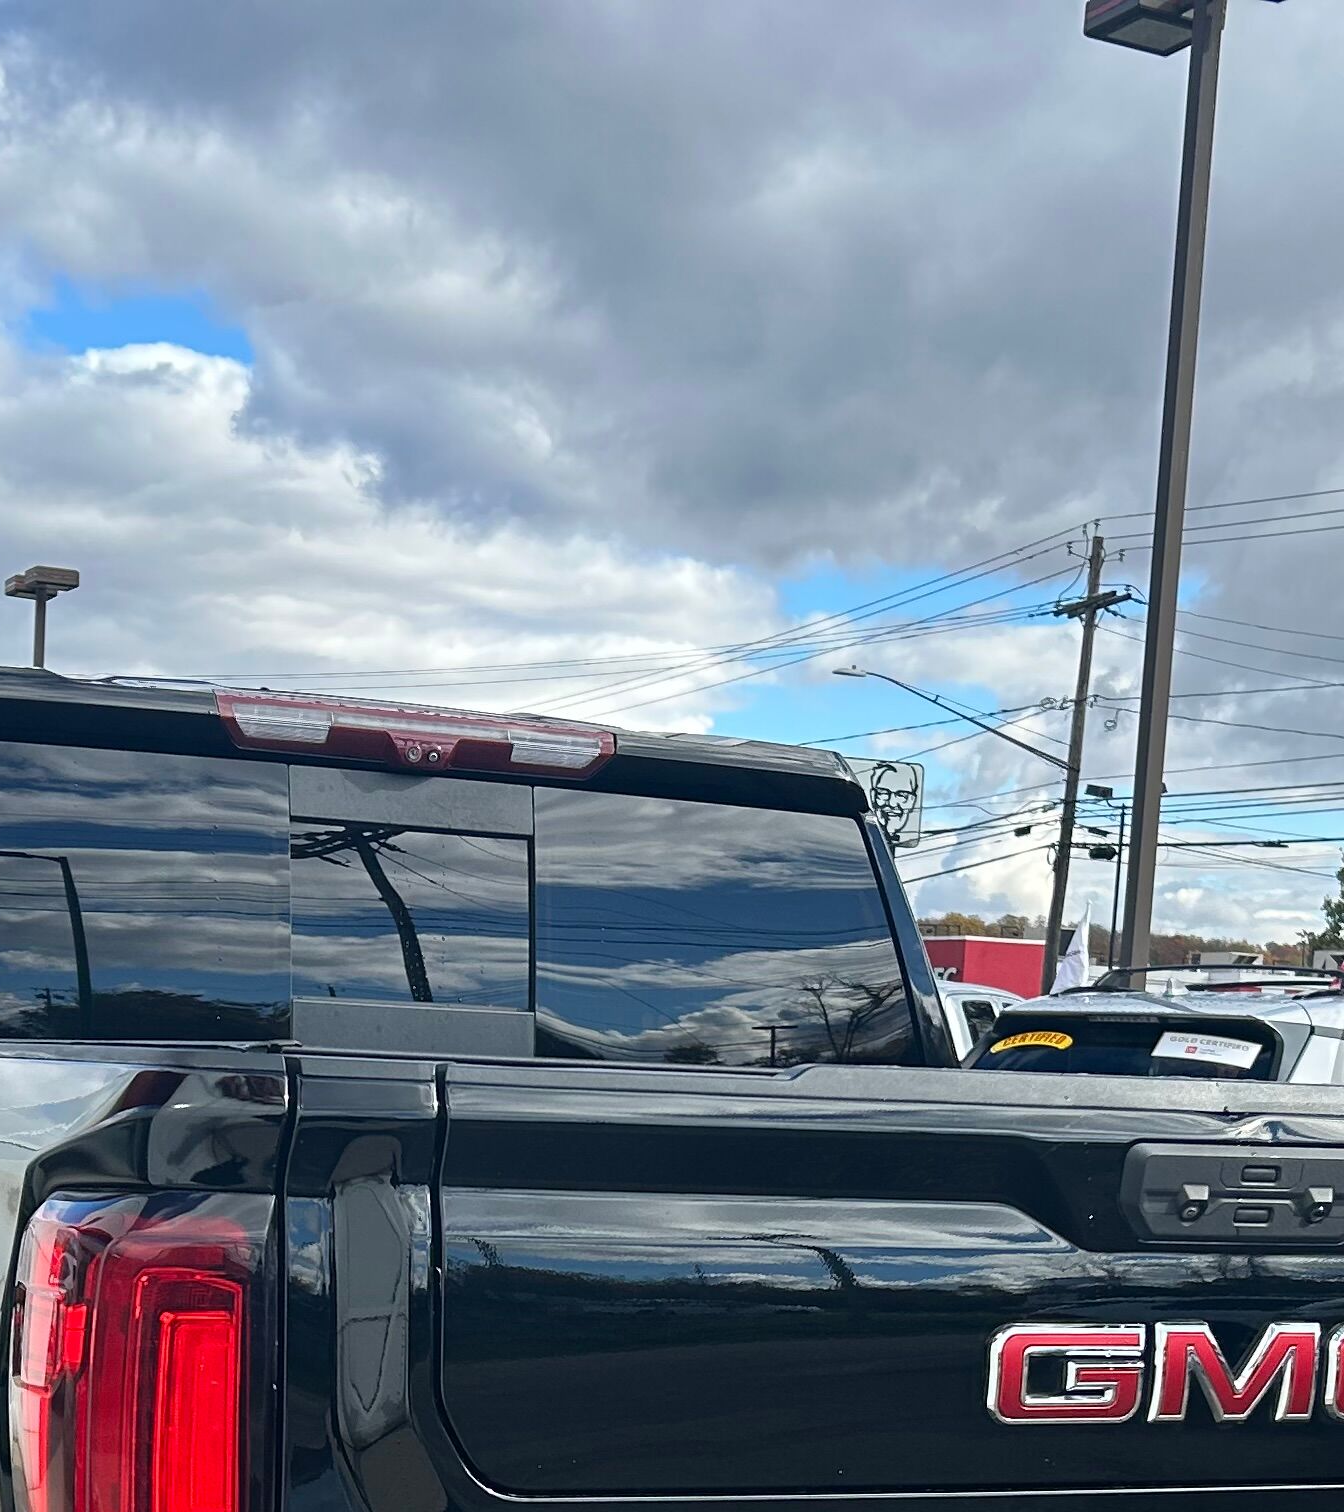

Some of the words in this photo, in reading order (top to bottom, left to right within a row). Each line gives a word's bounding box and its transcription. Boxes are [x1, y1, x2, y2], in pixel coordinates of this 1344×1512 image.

[933, 967, 957, 981] FC
[1170, 1036, 1198, 1044] GOLD
[1199, 1038, 1250, 1052] CERTIFIED
